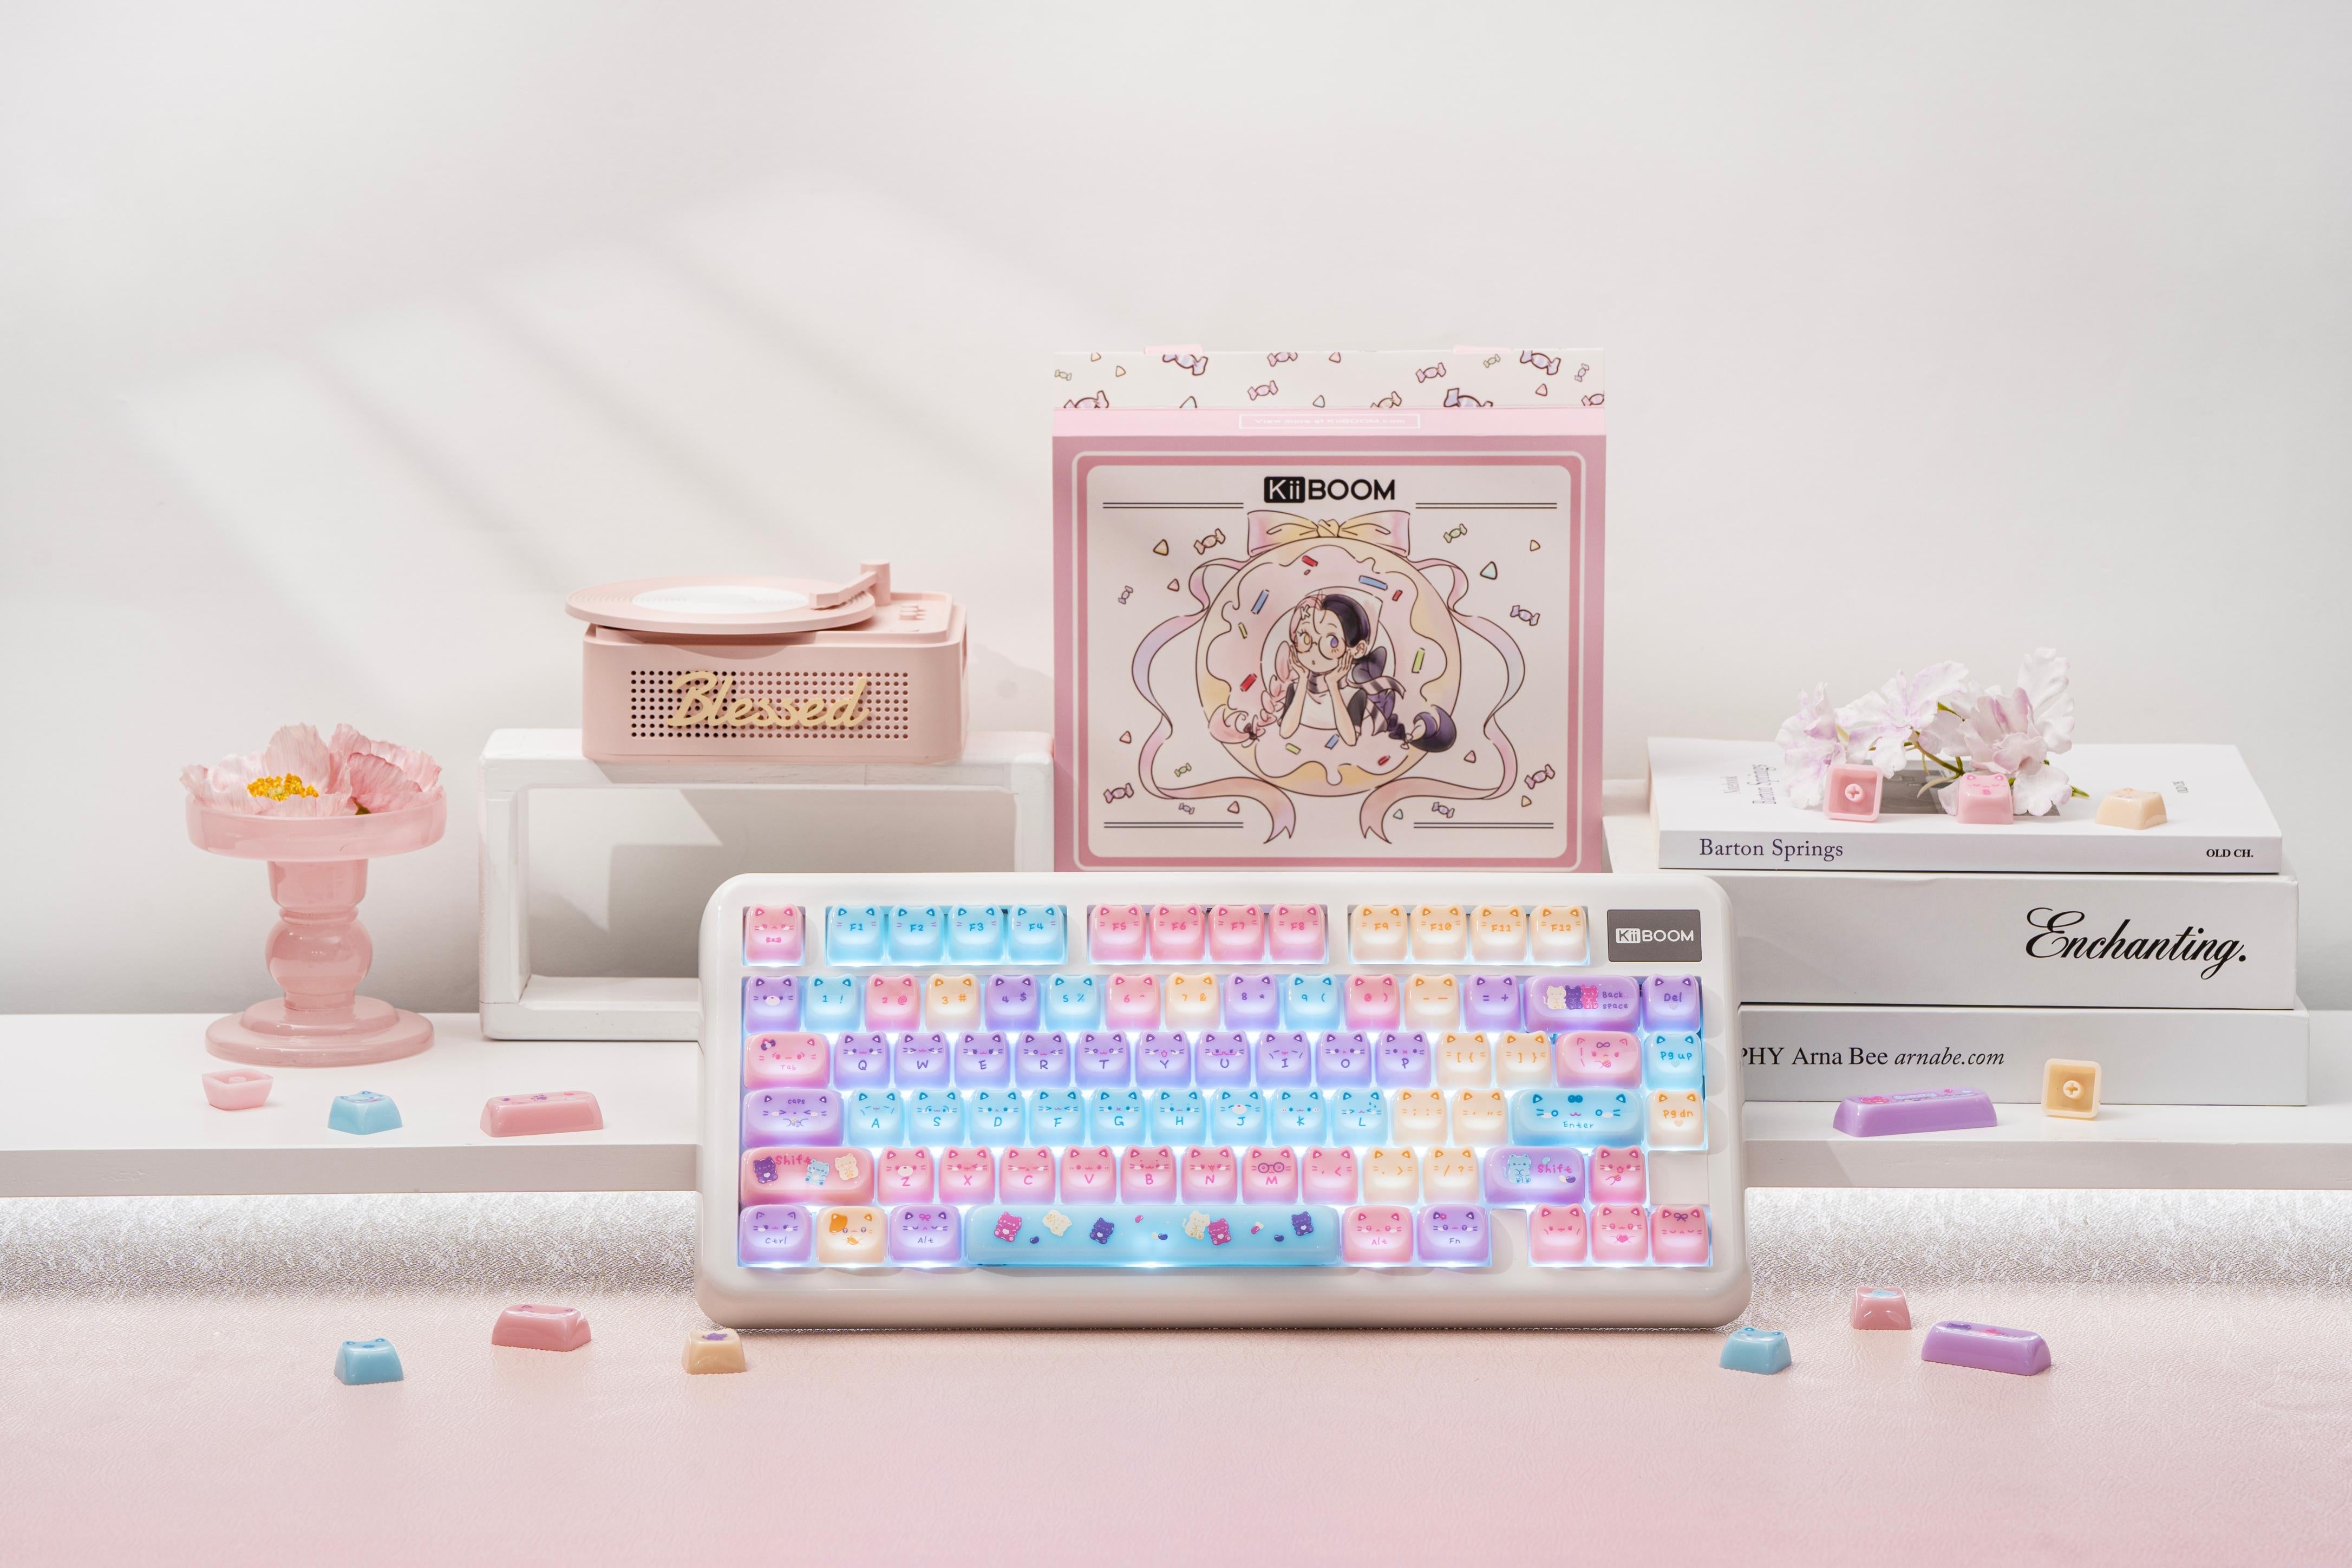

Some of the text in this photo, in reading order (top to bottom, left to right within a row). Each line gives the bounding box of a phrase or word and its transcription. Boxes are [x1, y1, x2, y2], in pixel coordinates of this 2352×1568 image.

[1264, 476, 1395, 503] KiiBOOM
[667, 670, 870, 729] Blessed
[1699, 838, 1844, 861] Barton Springs
[2206, 848, 2254, 858] OLD CH.
[850, 923, 864, 932] F1
[910, 924, 923, 932] F2
[969, 922, 984, 932] F3
[1028, 923, 1044, 932] F4
[1112, 922, 1127, 931] F5
[1171, 921, 1187, 931] F6
[1231, 921, 1245, 931] F7
[1290, 921, 1305, 931] F8
[1374, 922, 1389, 931] F9
[1491, 924, 1512, 932] F11
[1550, 924, 1571, 932] F12
[1616, 928, 1694, 943] KiiBOOM
[2026, 907, 2247, 980] Enchanting.
[942, 994, 966, 1005] 3 #
[1020, 991, 1027, 1002] $
[1063, 993, 1084, 1003] 5 %
[1123, 994, 1131, 1003] 6
[1181, 992, 1207, 1002] 7 &
[1241, 992, 1247, 1001] 8
[1663, 991, 1682, 1003] Del
[1677, 1053, 1693, 1061] up
[1791, 1047, 1843, 1065] Arna
[1848, 1047, 1888, 1065] Bee
[1894, 1047, 2004, 1065] arnabe.com
[858, 1059, 867, 1071] Q
[917, 1060, 929, 1070] W
[978, 1060, 986, 1070] E
[1040, 1059, 1048, 1070] R
[1099, 1059, 1109, 1069] T
[1159, 1059, 1170, 1069] Y
[1220, 1058, 1230, 1068] U
[1282, 1057, 1289, 1068] I
[1401, 1057, 1409, 1069] P
[1680, 1109, 1694, 1118] dn
[871, 1118, 880, 1128] A
[933, 1116, 941, 1127] S
[994, 1116, 1002, 1127] D
[1054, 1117, 1062, 1127] F
[1114, 1115, 1124, 1126] G
[1175, 1115, 1184, 1126] H
[1237, 1116, 1246, 1126] J
[1358, 1117, 1366, 1127] L
[775, 1155, 811, 1166] Shift
[1537, 1164, 1572, 1174] Shift
[900, 1175, 910, 1187] Z
[964, 1174, 972, 1186] X
[1023, 1174, 1033, 1185] C
[1084, 1173, 1094, 1184] V
[1145, 1173, 1154, 1185] B
[1205, 1174, 1215, 1185] N
[1266, 1176, 1278, 1185] M
[765, 1236, 787, 1245] Ctrl
[918, 1236, 933, 1244] Alt
[1371, 1237, 1388, 1246] Alt
